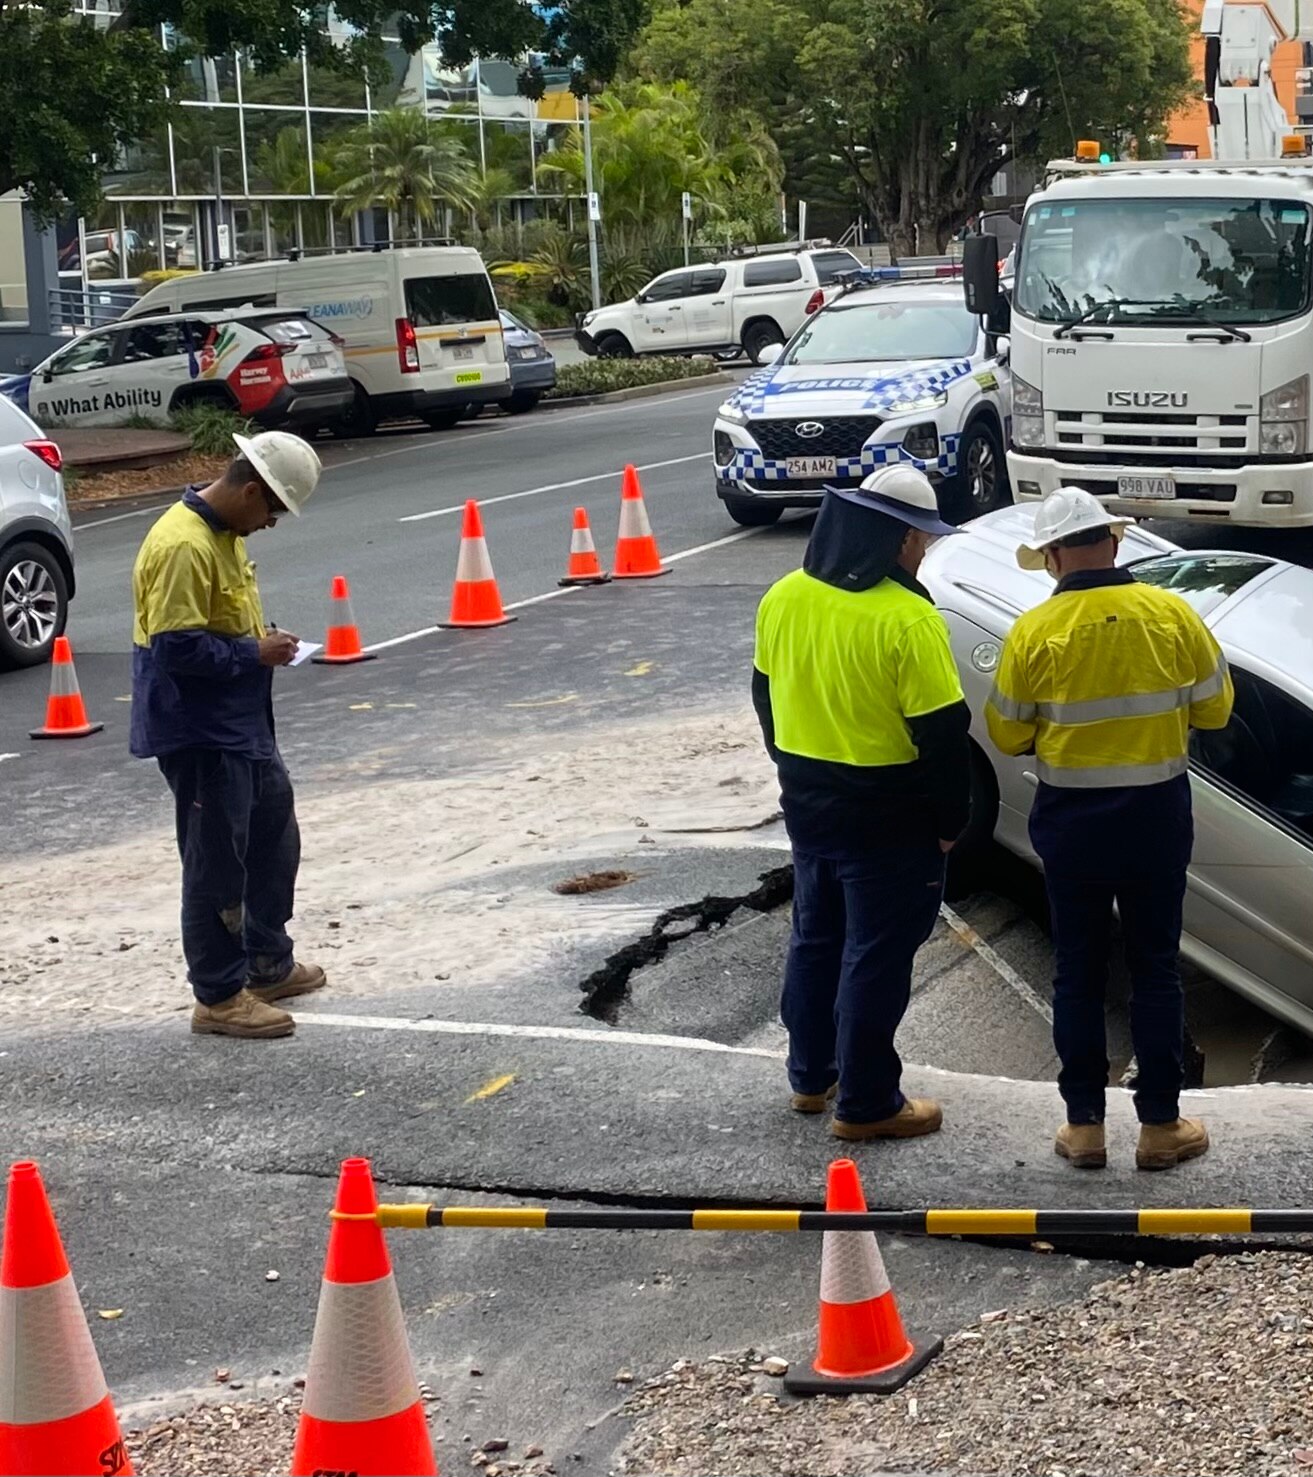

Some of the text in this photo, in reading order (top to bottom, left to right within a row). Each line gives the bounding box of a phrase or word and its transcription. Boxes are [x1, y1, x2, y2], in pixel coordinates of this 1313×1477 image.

[778, 379, 878, 393] POLICE
[51, 388, 162, 416] What Ability
[1106, 390, 1189, 409] ISUZU
[787, 458, 834, 474] 254 AM2
[1120, 479, 1174, 494] 998 VAU
